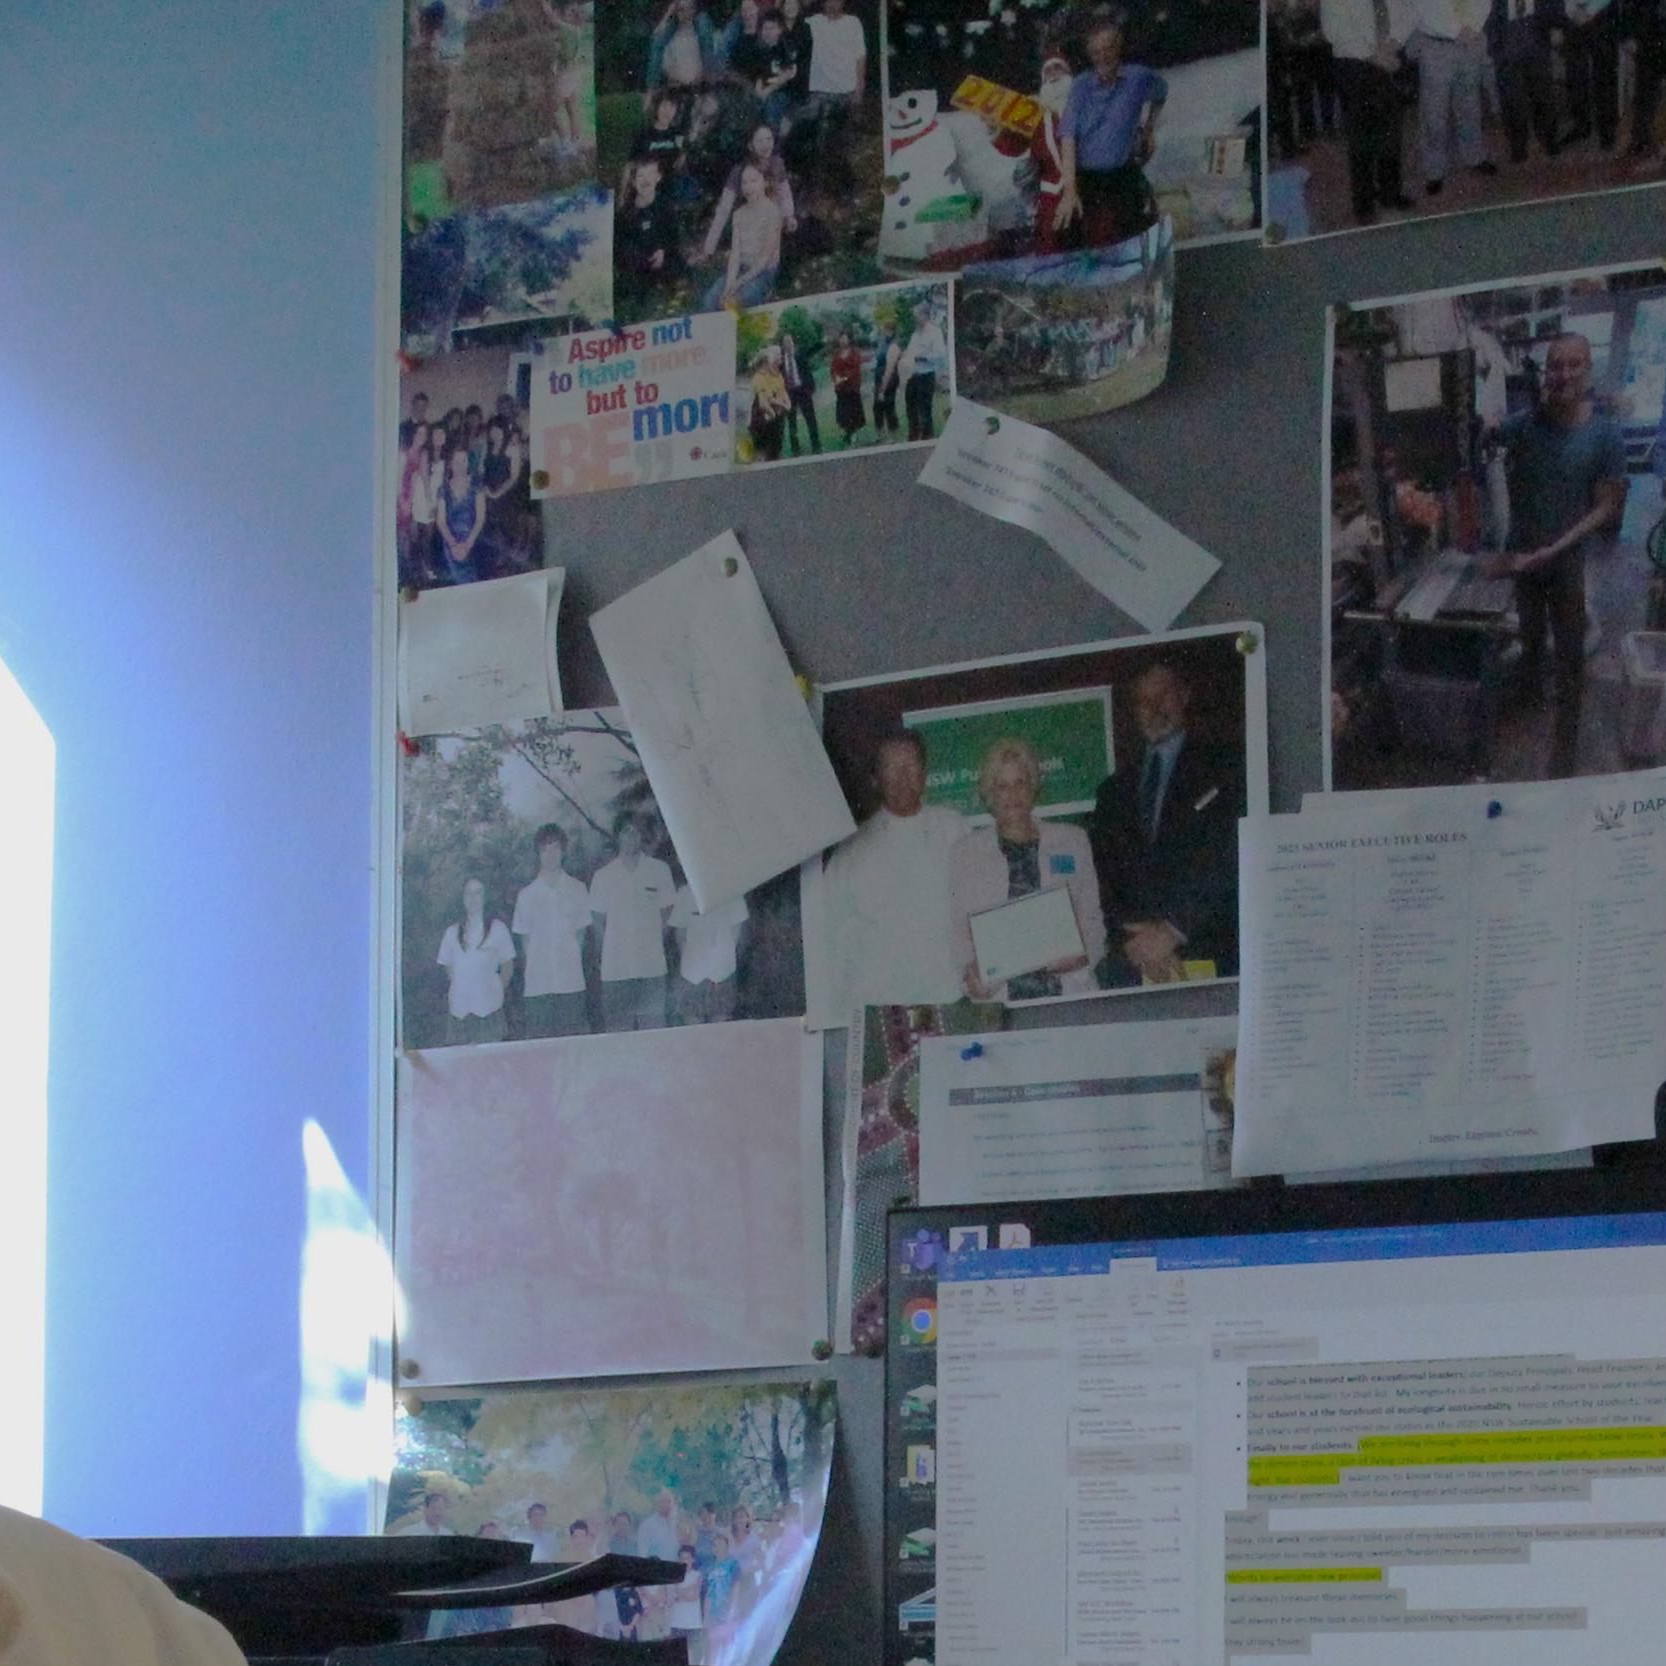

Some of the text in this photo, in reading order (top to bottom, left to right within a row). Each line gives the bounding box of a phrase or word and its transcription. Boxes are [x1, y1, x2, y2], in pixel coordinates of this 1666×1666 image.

[568, 315, 693, 364] Aspire not
[549, 369, 573, 395] to
[578, 358, 637, 389] have
[586, 380, 659, 416] but to
[543, 411, 633, 496] BE
[1302, 839, 1348, 852] SENIOR
[1350, 833, 1421, 849] EXECUTIVE
[1423, 831, 1468, 844] ROLES
